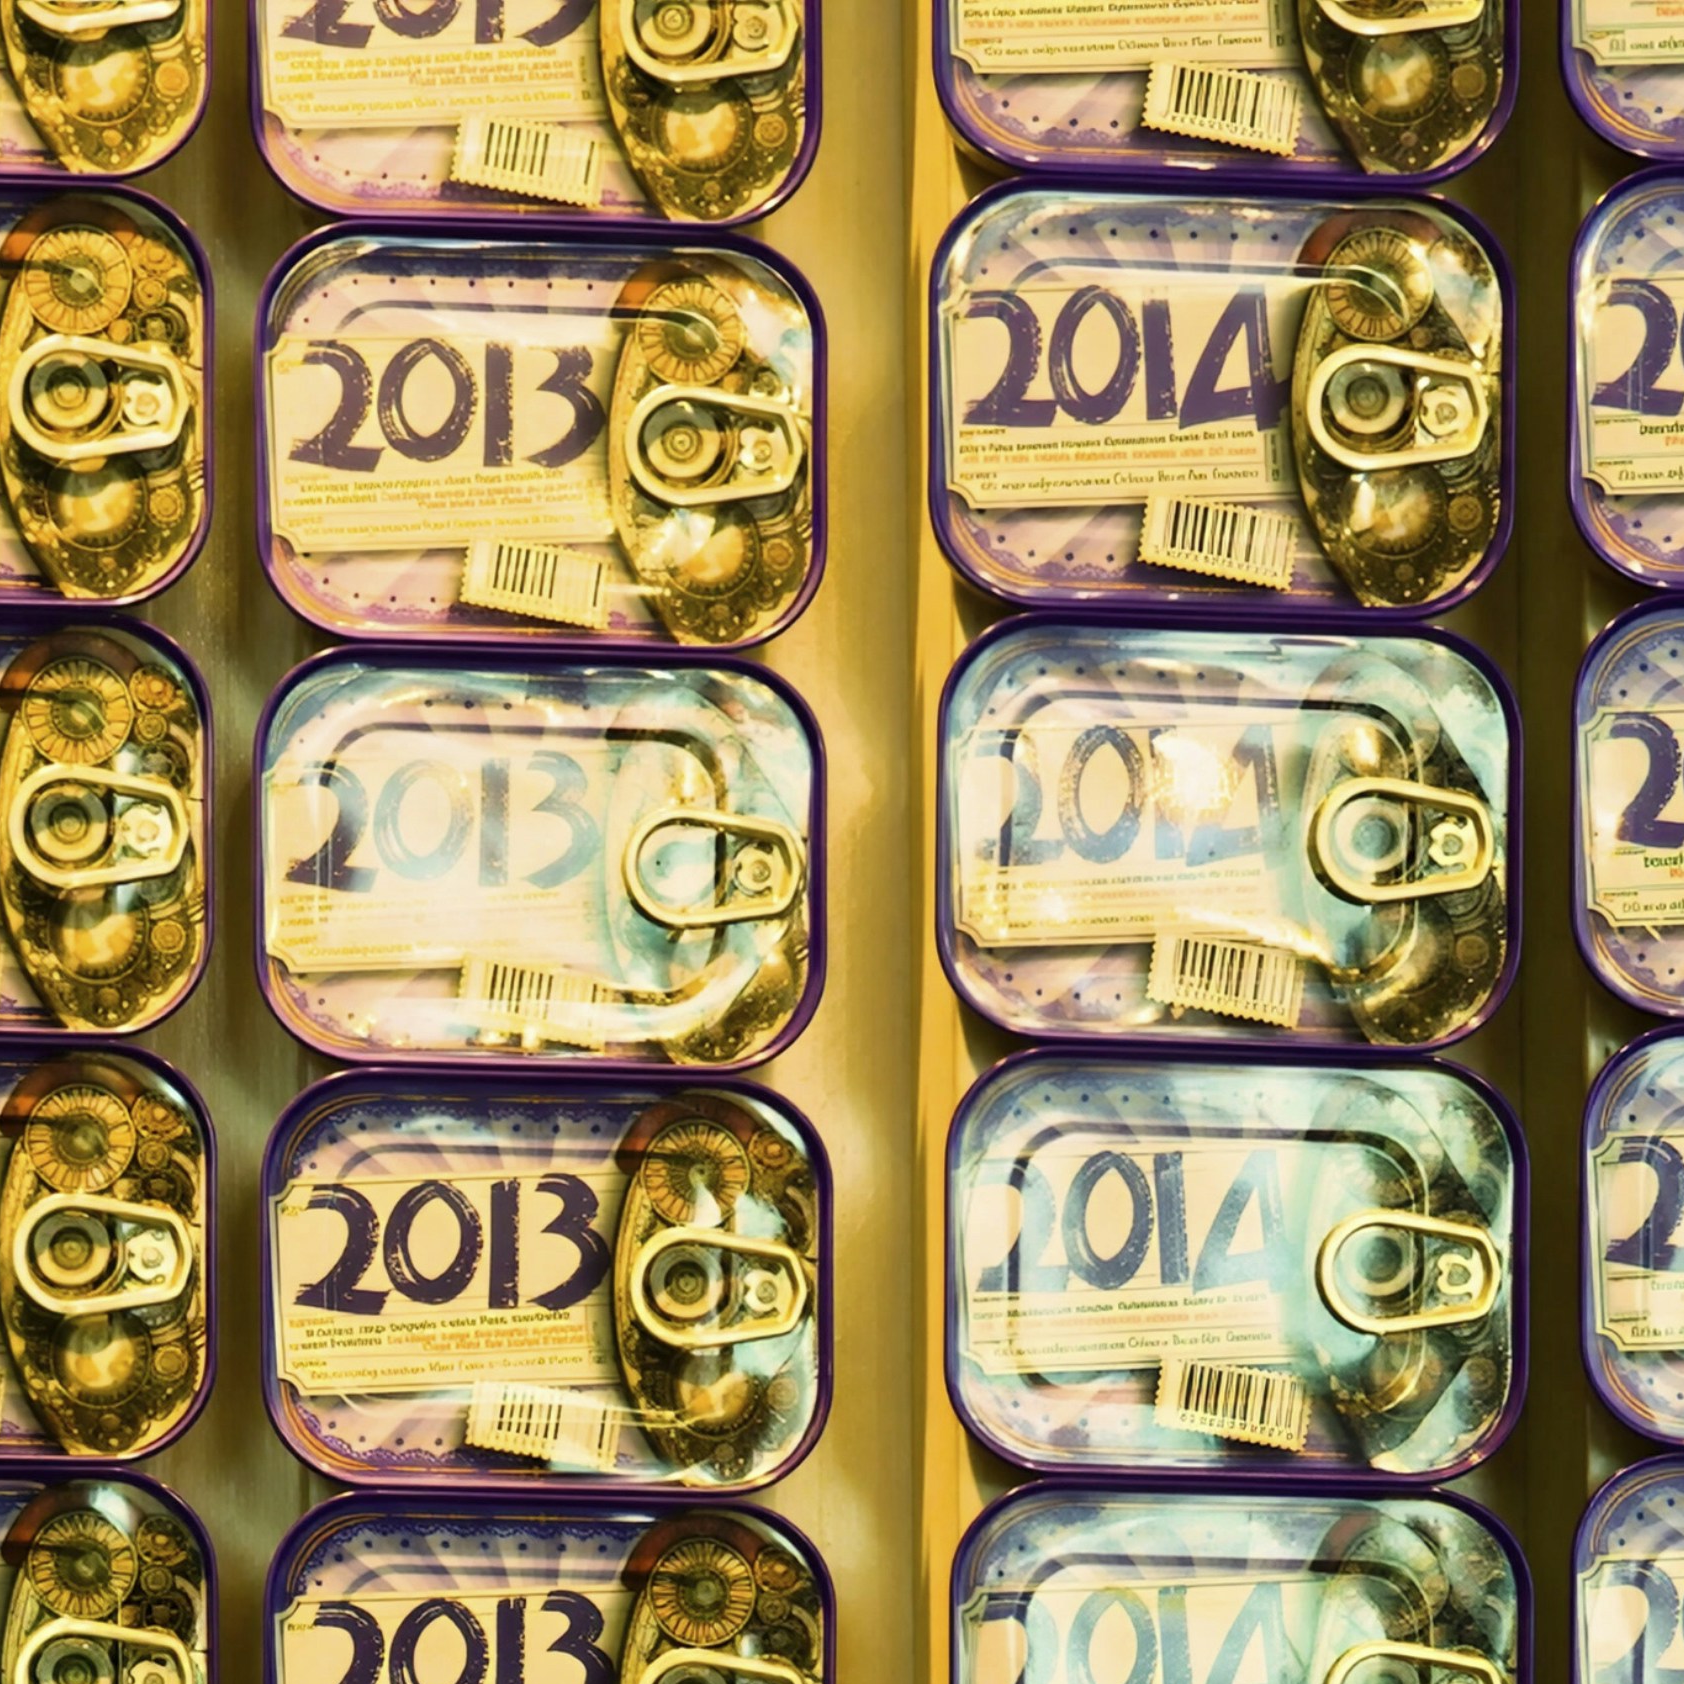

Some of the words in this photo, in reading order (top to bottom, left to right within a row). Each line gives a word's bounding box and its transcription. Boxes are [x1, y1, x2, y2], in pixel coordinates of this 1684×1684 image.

[292, 337, 606, 469] 2013
[964, 286, 1294, 430] 2014
[287, 753, 605, 890] 2013
[295, 1172, 611, 1311] 2013
[975, 1150, 1288, 1295] 2014
